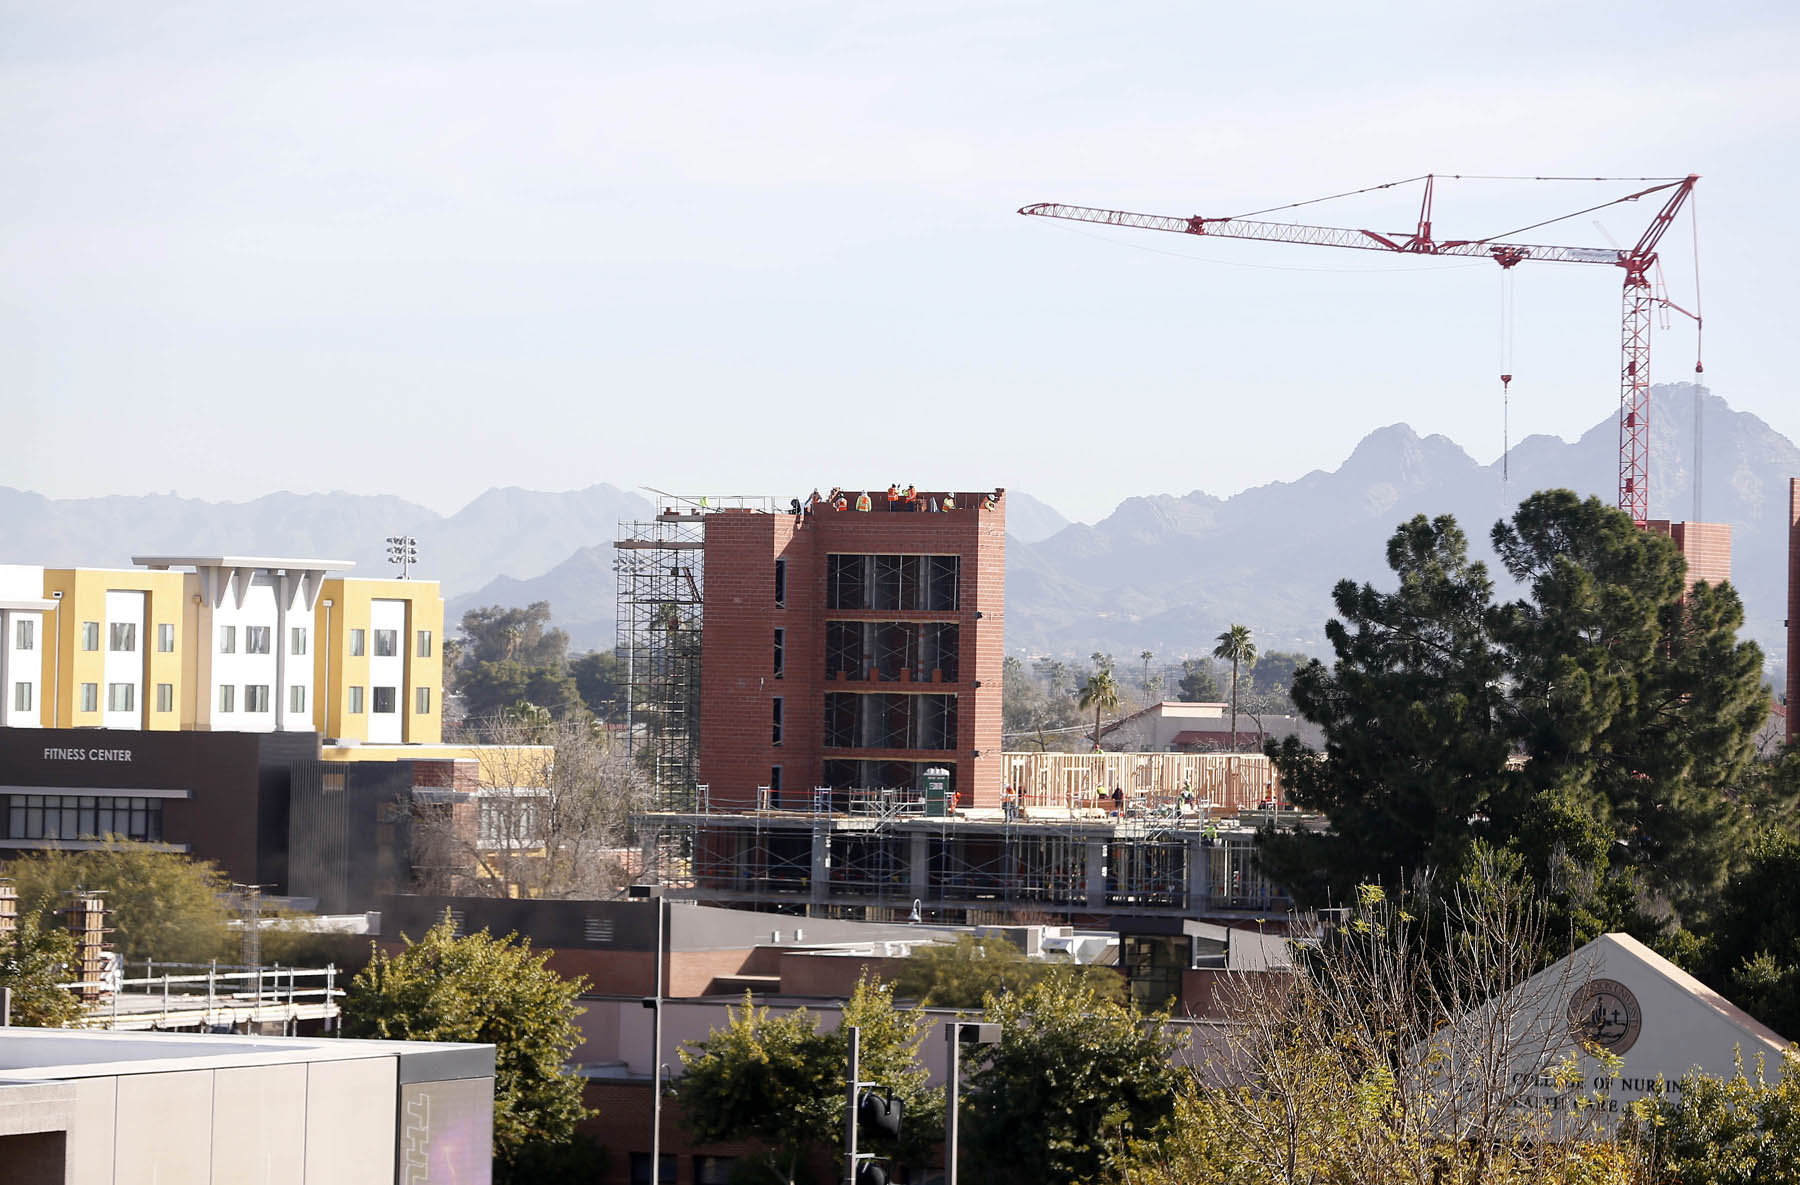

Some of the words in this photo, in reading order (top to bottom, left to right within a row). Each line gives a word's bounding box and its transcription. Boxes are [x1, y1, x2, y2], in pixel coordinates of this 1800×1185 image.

[44, 748, 86, 760] FITNESS
[88, 749, 132, 761] CENTER
[1512, 1072, 1584, 1089] COLLE
[1594, 1076, 1613, 1090] OF
[1621, 1078, 1689, 1093] NURIN
